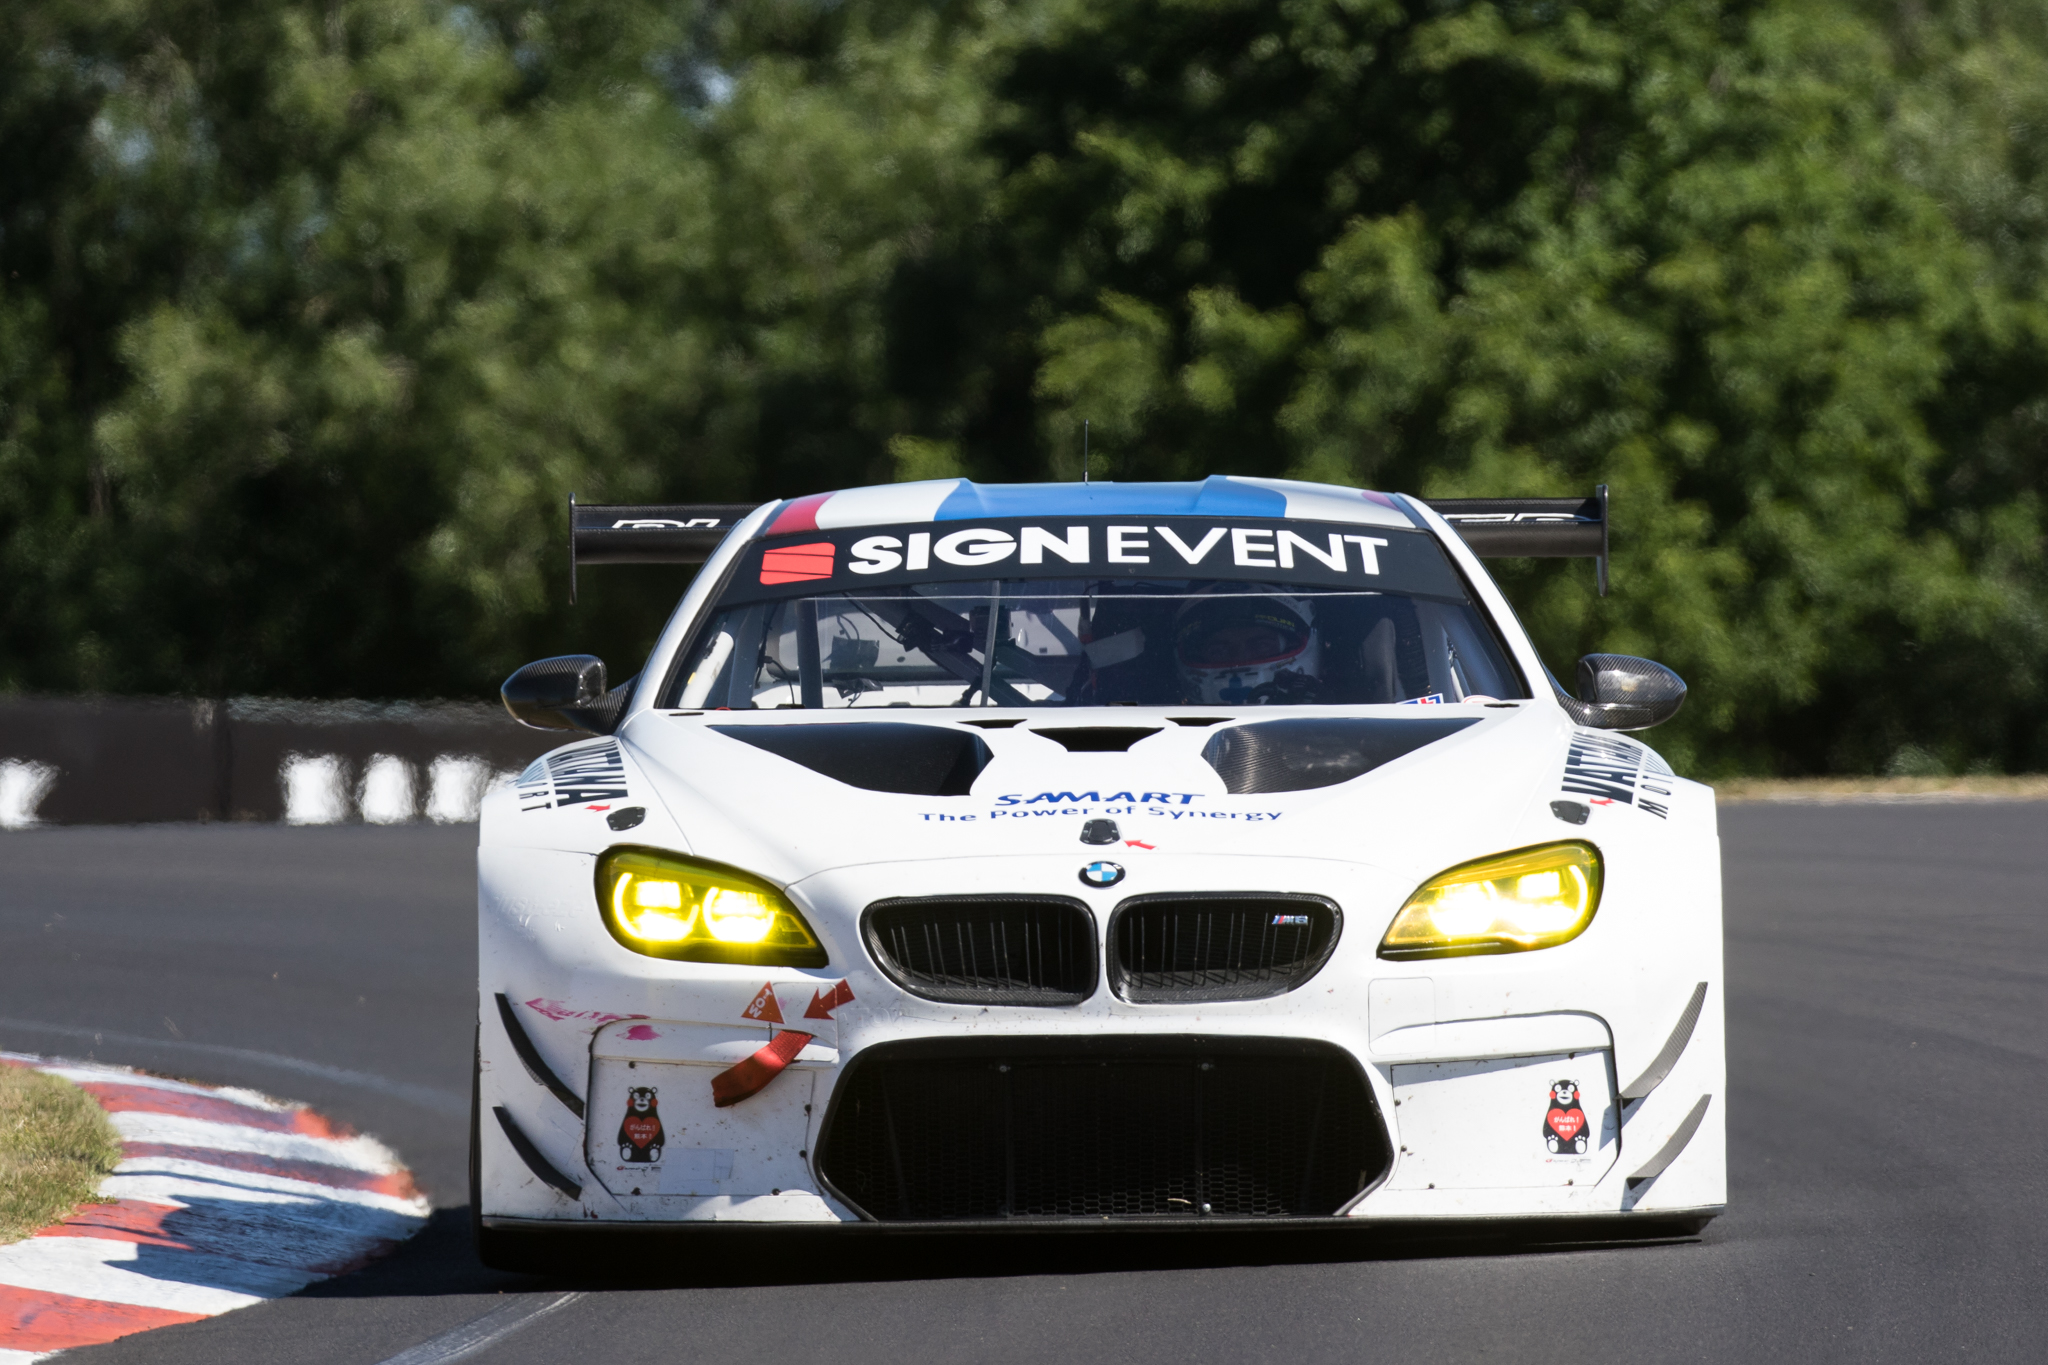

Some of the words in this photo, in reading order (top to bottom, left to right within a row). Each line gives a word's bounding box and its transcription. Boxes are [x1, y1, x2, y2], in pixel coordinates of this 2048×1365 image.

[995, 791, 1205, 806] SAMART
[918, 812, 977, 823] The
[990, 806, 1094, 821] Power
[1105, 804, 1137, 816] of
[1147, 806, 1284, 823] Synergy
[747, 988, 773, 1019] TOW
